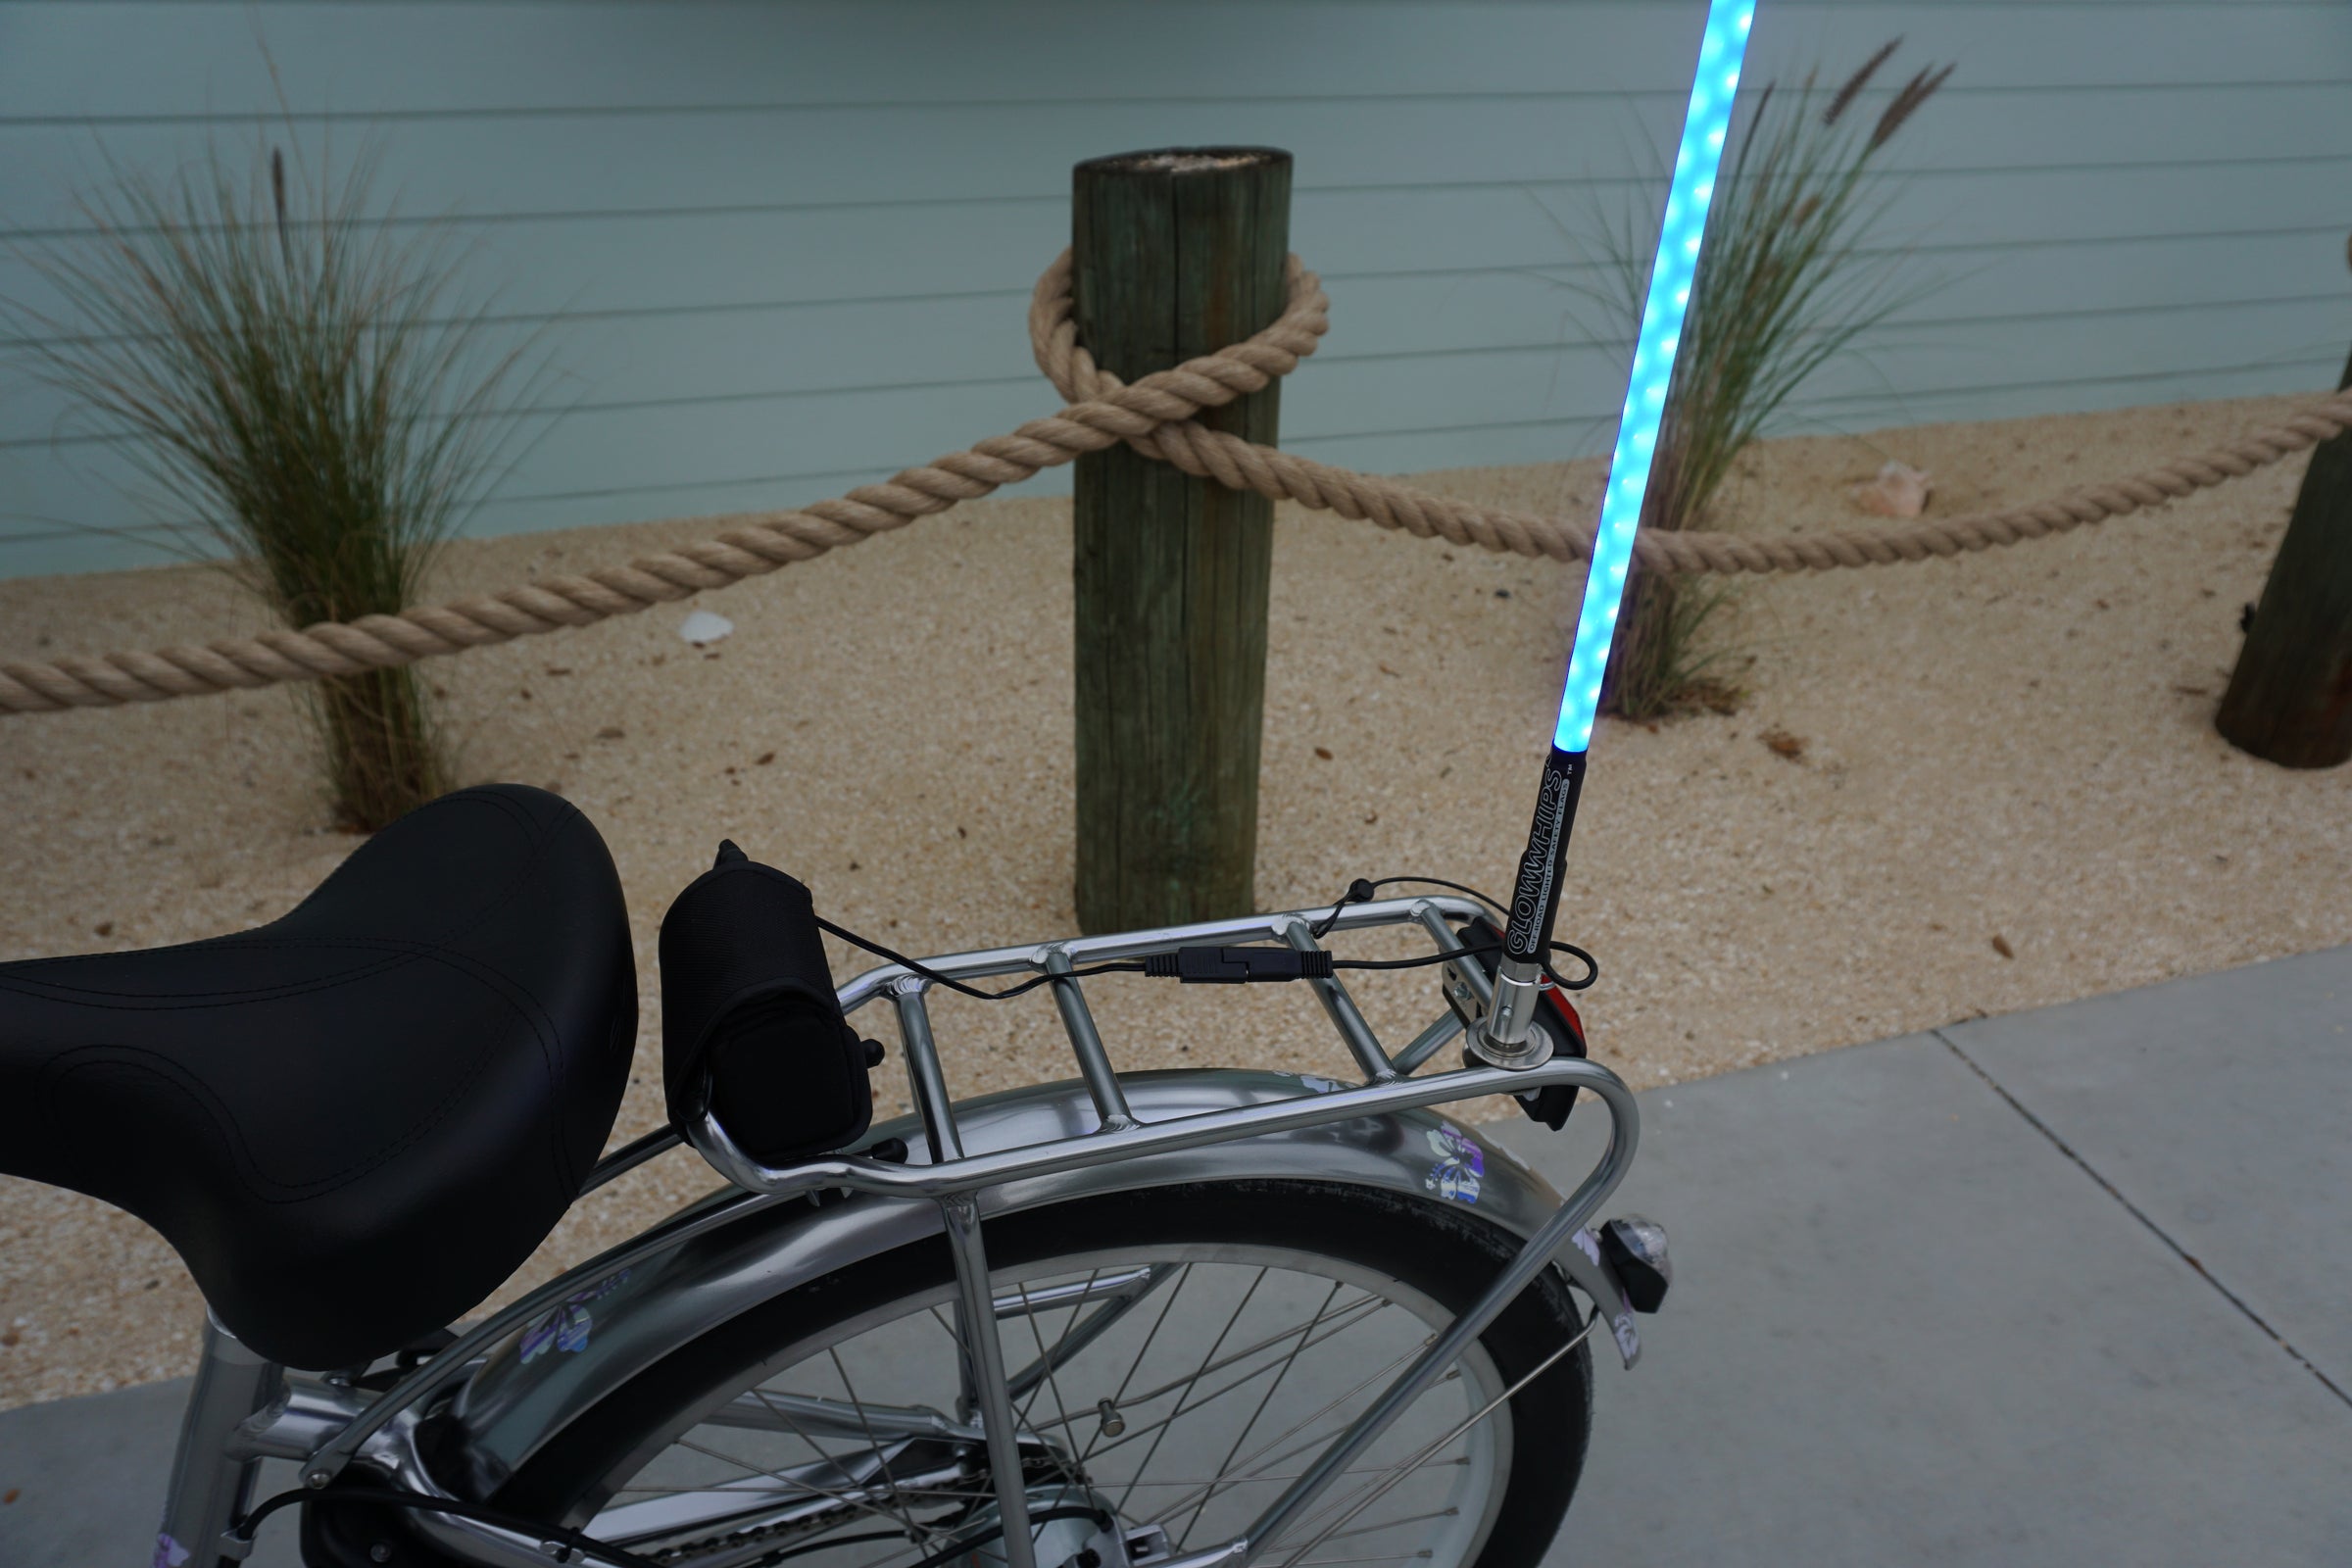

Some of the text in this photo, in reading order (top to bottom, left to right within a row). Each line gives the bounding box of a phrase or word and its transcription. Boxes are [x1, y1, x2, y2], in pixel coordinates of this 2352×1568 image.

[1507, 769, 1562, 955] GLOWWHIPS
[1529, 782, 1568, 951] OFF-ROAD LIGHTED SAFETY FLAGS
